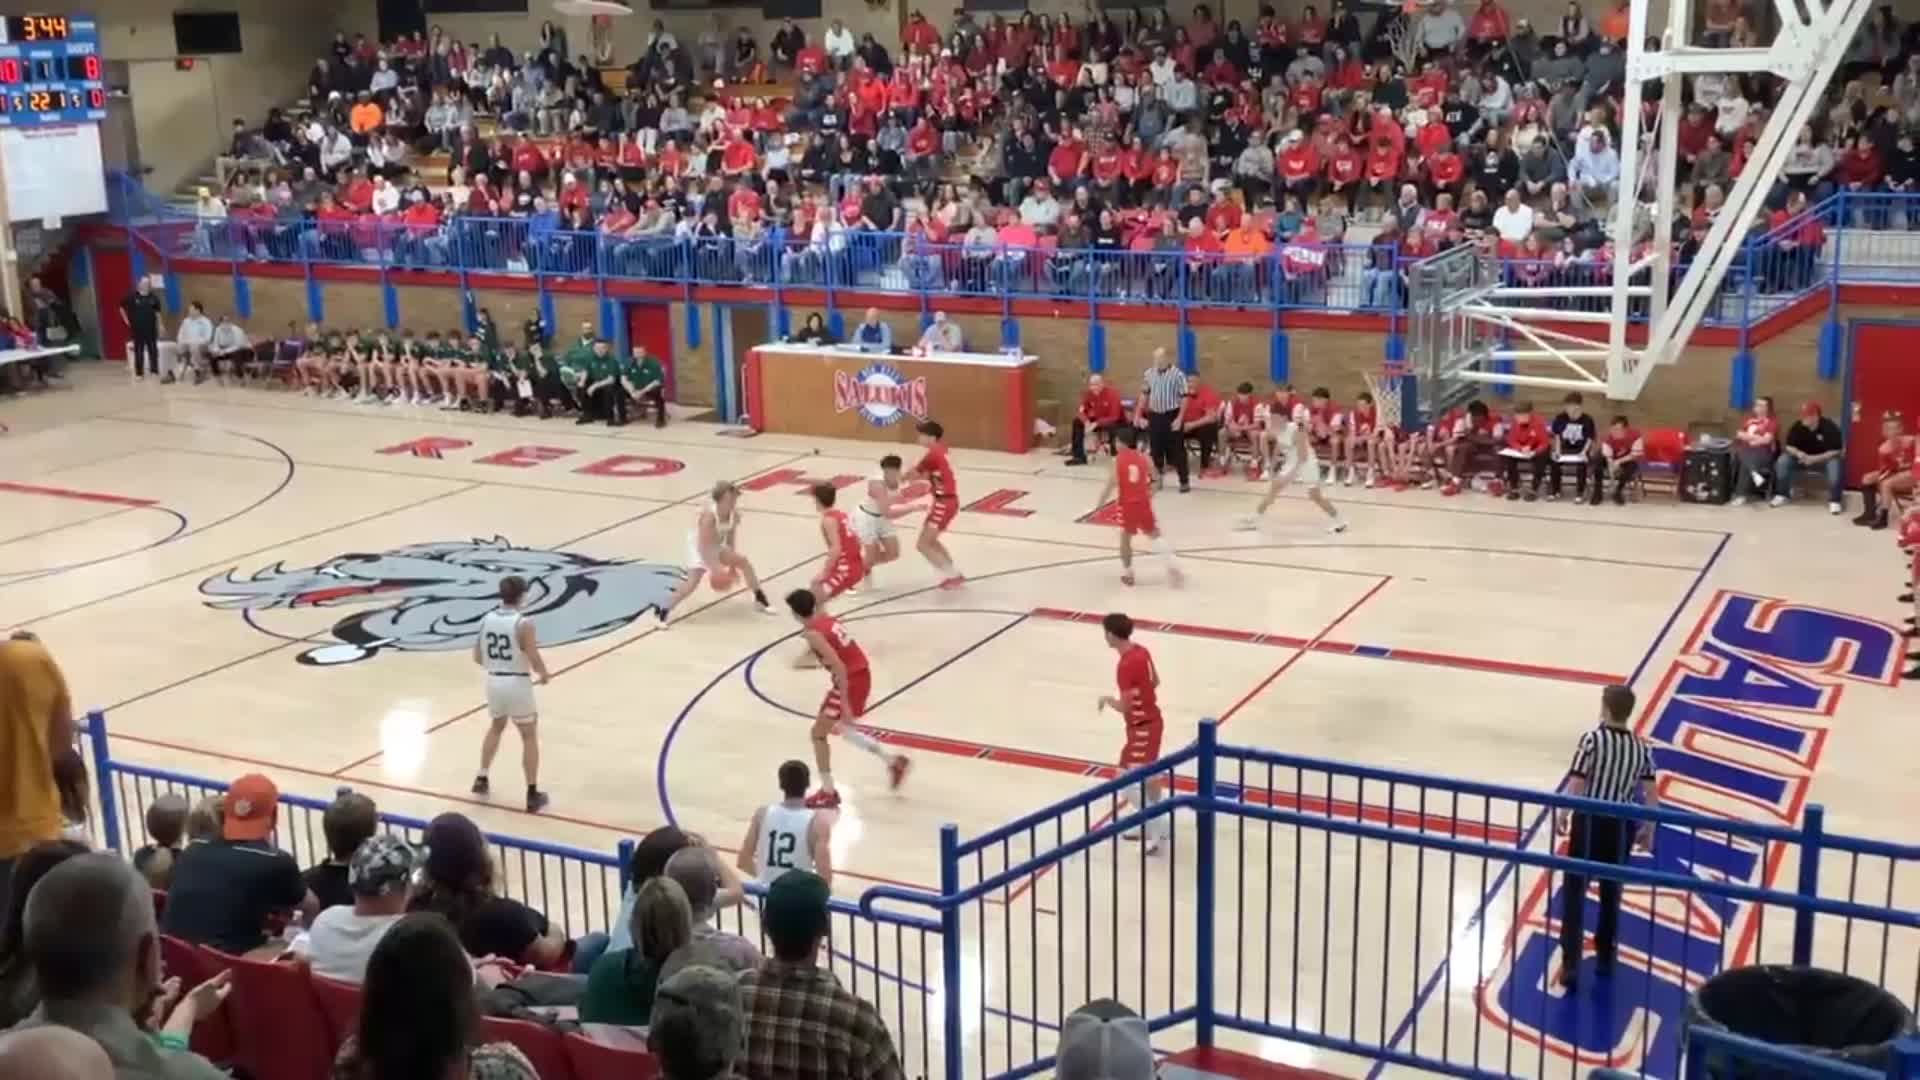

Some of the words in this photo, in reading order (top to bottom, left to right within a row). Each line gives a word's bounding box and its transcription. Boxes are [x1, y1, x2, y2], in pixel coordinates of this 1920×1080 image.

[23, 16, 67, 40] 3:44
[85, 56, 99, 80] 8
[374, 436, 686, 478] RED
[486, 632, 513, 661] 22
[767, 830, 796, 868] 12
